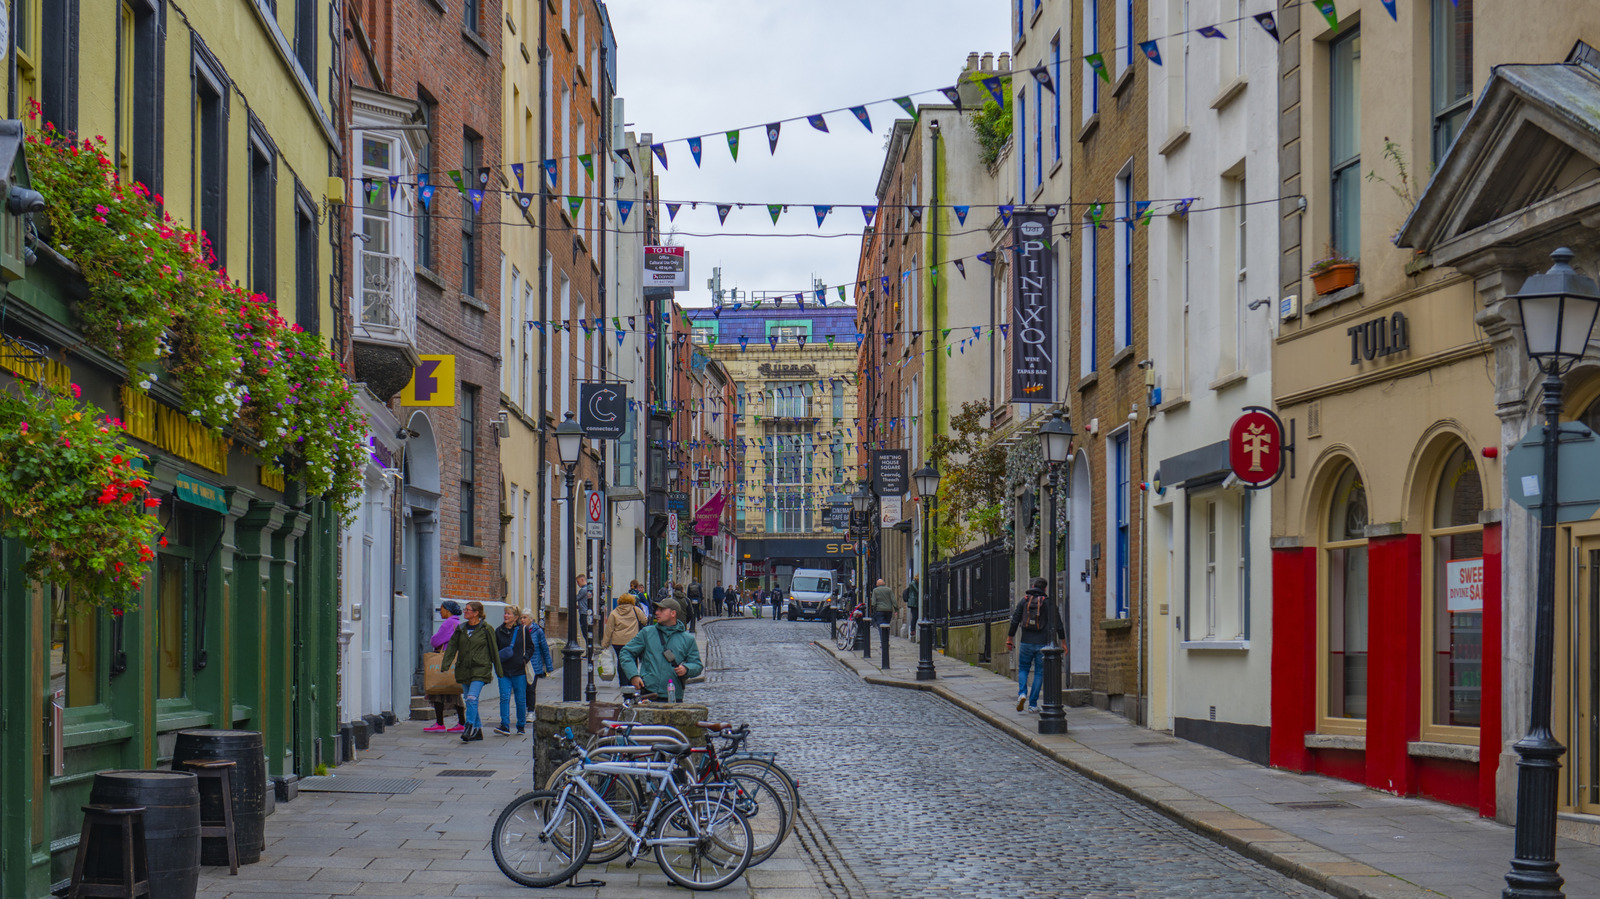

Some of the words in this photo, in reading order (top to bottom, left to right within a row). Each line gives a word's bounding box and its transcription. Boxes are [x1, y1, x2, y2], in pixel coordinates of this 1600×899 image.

[1019, 240, 1046, 344] PINTXO
[1347, 311, 1408, 365] TULA
[757, 363, 820, 376] BURTON
[826, 544, 853, 553] SP
[1459, 566, 1483, 584] SWEE
[1449, 587, 1469, 599] DIVINE
